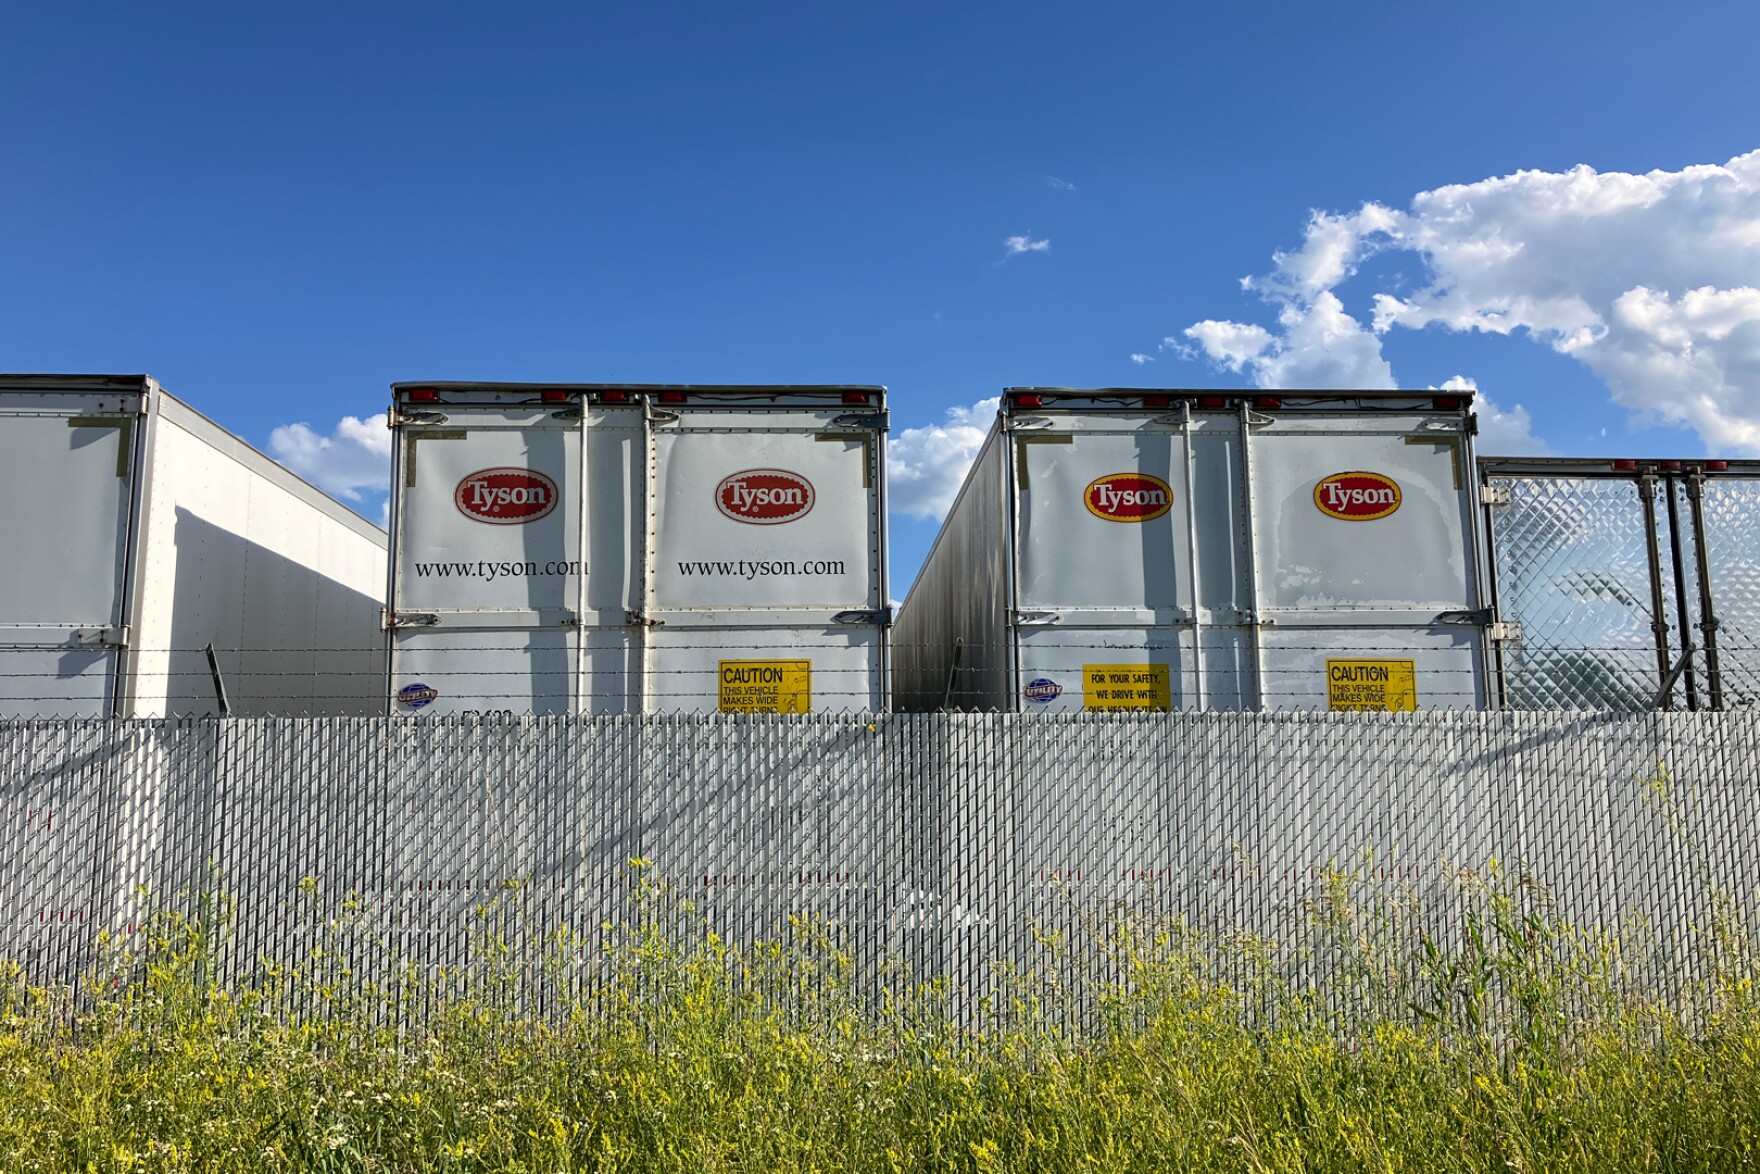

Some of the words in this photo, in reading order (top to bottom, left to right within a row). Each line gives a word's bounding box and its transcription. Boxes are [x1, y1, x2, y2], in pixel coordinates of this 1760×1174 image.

[467, 481, 546, 512] Tyson
[726, 481, 804, 512] Tyson
[1093, 484, 1167, 513] Tyson
[1321, 482, 1396, 511] Tyson
[415, 560, 589, 582] www.tyson.com
[678, 559, 846, 581] www.tyson.com
[723, 667, 783, 683] CAUTION
[1091, 674, 1105, 683] FOR
[1108, 674, 1129, 684] YOUR
[1133, 674, 1161, 684] SAFETY,
[1331, 666, 1389, 682] CAUTION
[723, 686, 742, 695] THIS
[744, 686, 779, 695] VEHICLE
[1026, 685, 1062, 696] UTILITY
[1096, 690, 1109, 699] WE
[1111, 690, 1134, 699] DRIVE
[1136, 690, 1157, 699] WITH
[1332, 684, 1350, 693] THIS
[1352, 684, 1385, 693] VEHICLE
[723, 696, 754, 705] MAKES
[756, 696, 779, 705] WIDE
[1332, 694, 1362, 703] MAKES
[1364, 694, 1386, 703] WIDE
